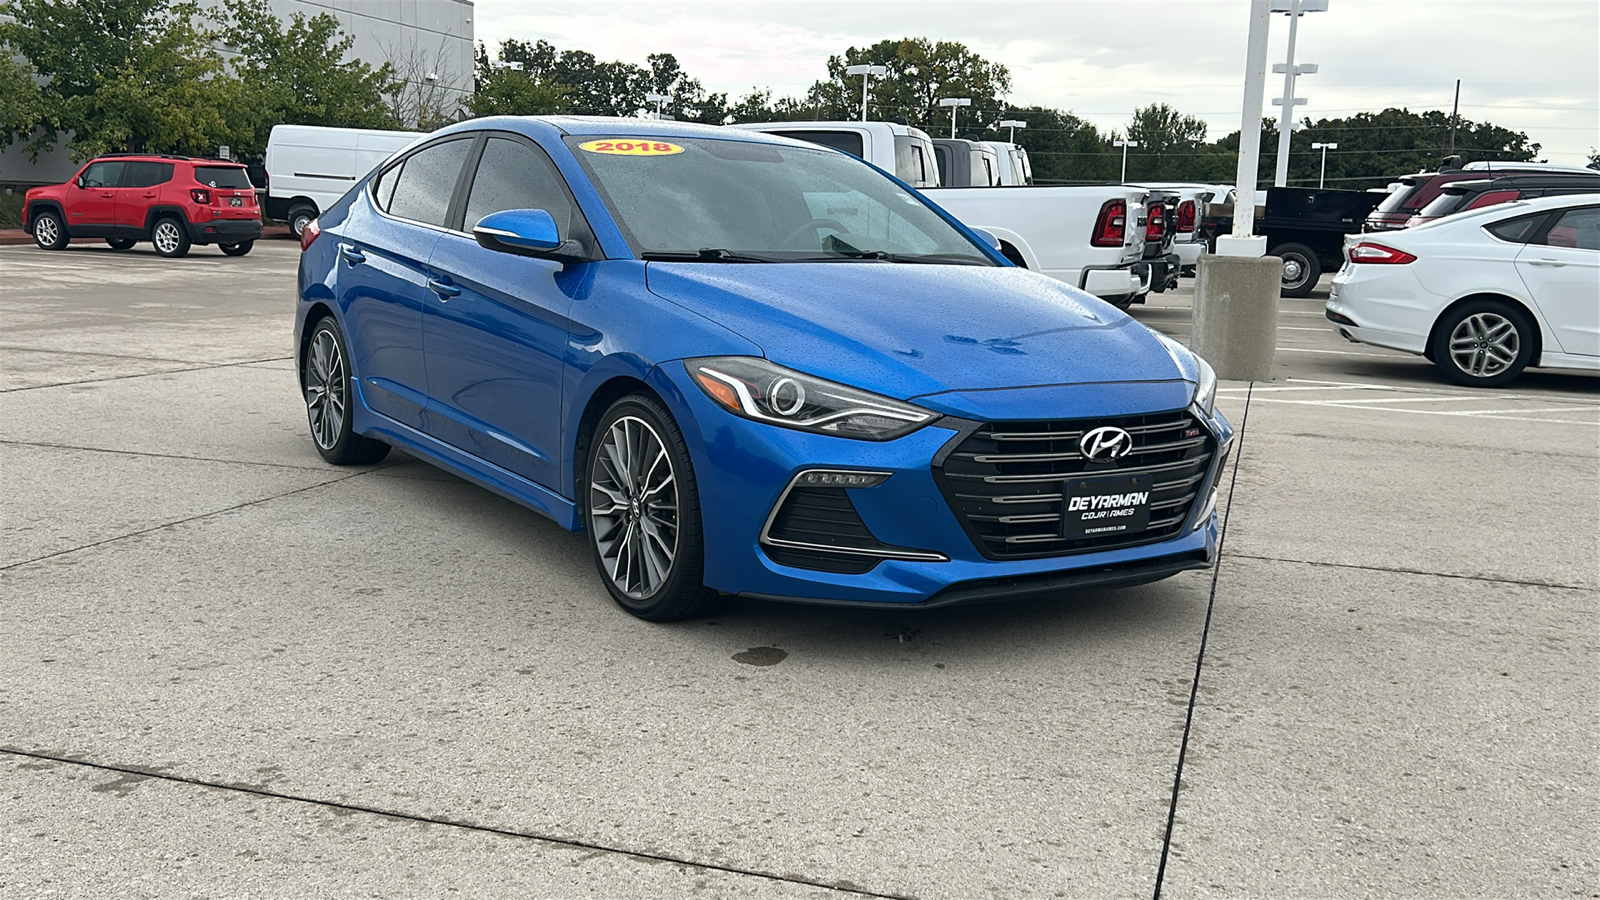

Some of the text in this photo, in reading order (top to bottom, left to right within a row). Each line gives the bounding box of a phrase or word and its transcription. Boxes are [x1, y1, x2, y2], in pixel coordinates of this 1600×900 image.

[595, 142, 672, 152] 2018
[1068, 491, 1149, 512] DEYARMAN
[1109, 508, 1135, 518] AMES
